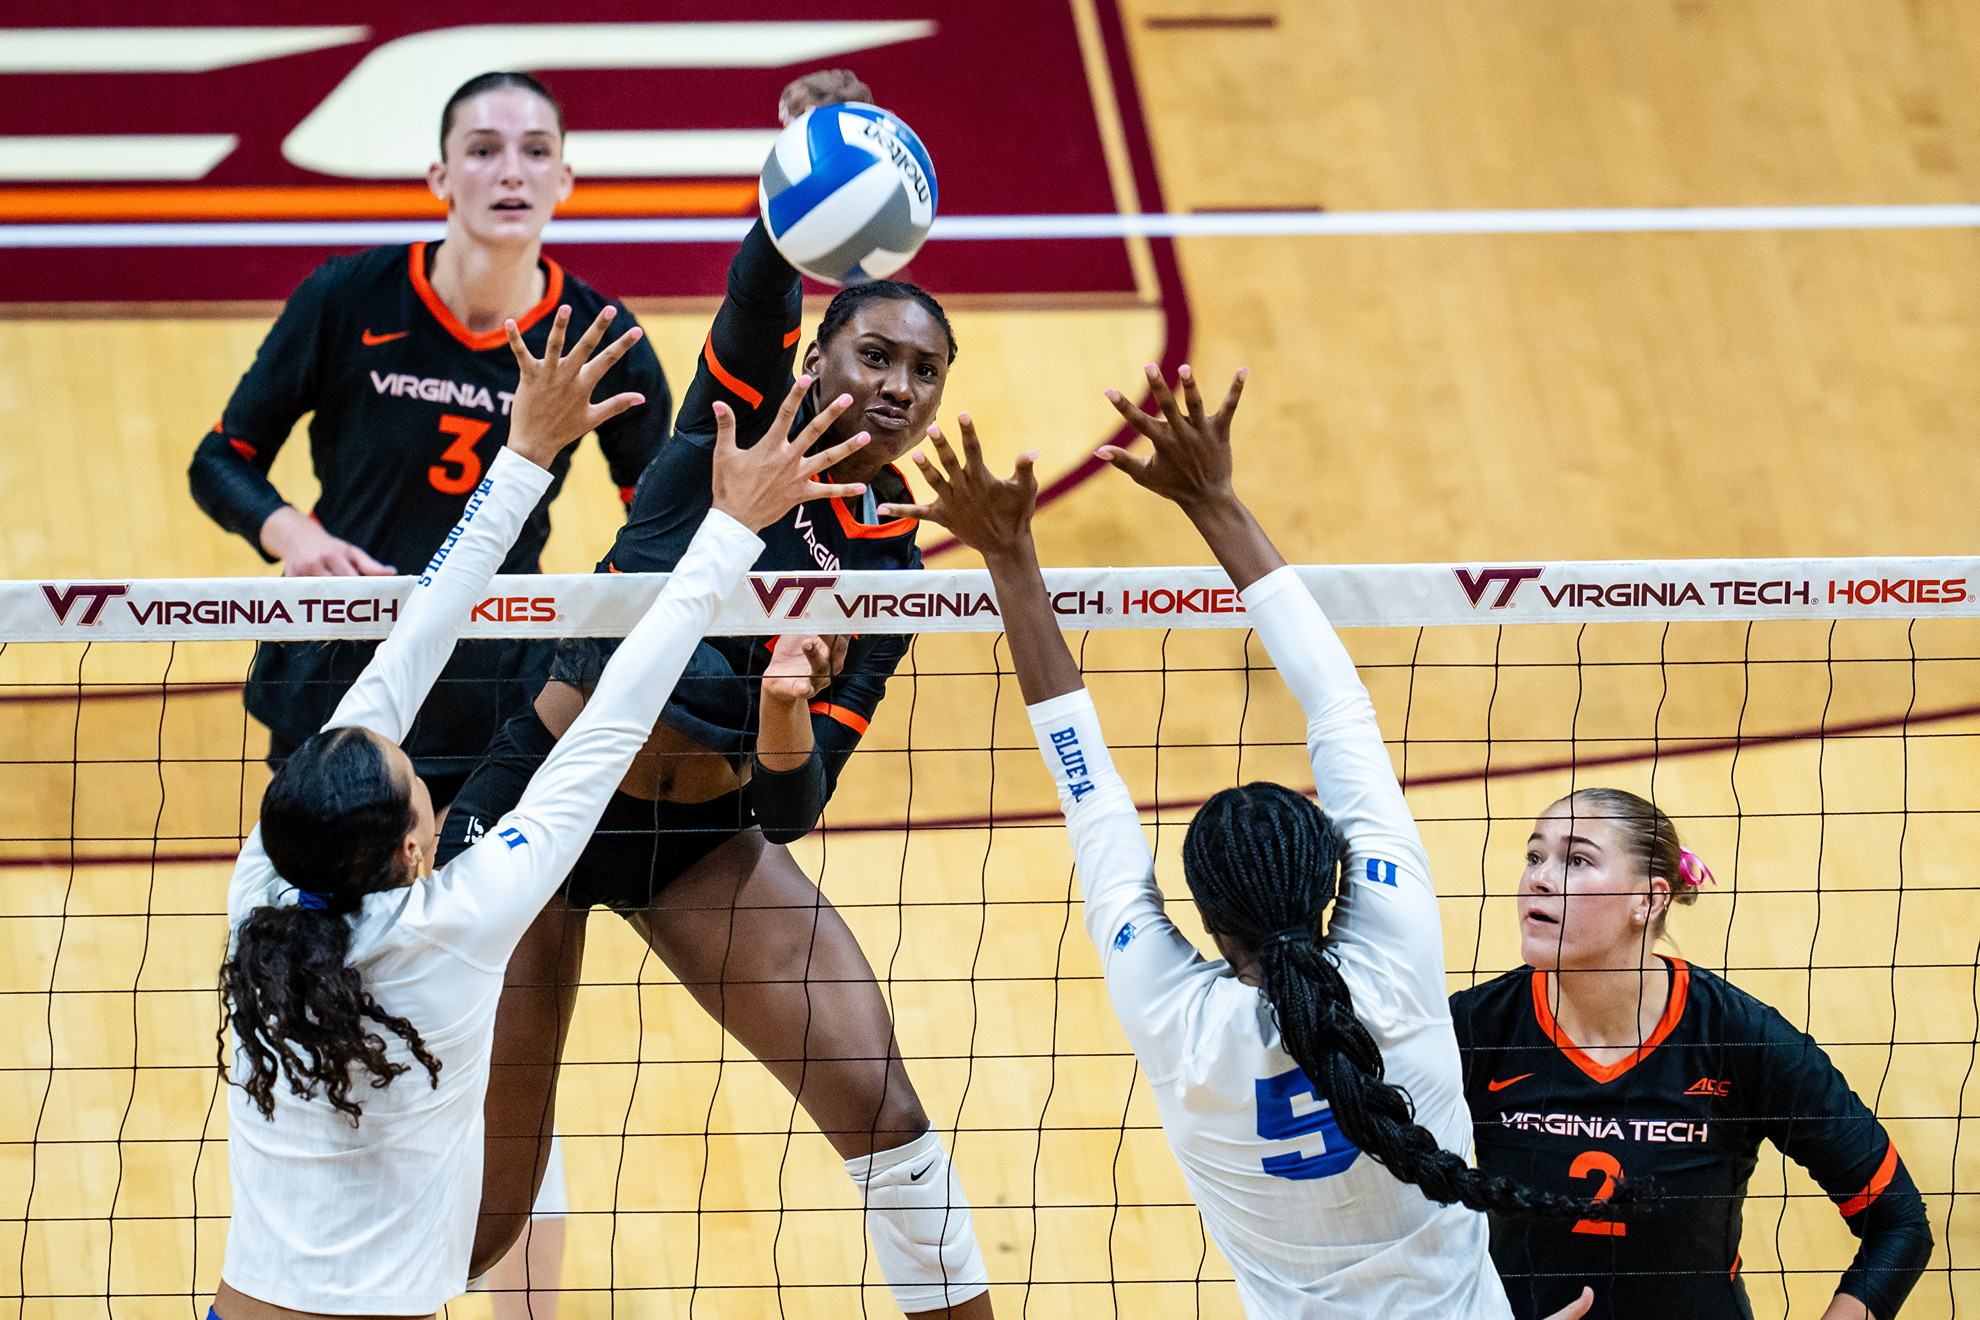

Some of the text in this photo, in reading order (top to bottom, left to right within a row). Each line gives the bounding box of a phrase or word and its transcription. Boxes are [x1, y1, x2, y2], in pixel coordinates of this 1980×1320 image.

[863, 124, 930, 203] molten
[370, 370, 495, 413] VIRGINIA
[428, 414, 492, 495] 3
[38, 582, 556, 626] VT VIRGINIA TECH KIES
[746, 574, 841, 619] VT
[833, 592, 1000, 619] VIRGINIA
[1451, 566, 1967, 610] VT VIRGINIA TECH HOKIES
[1050, 726, 1088, 779] BLUE
[1686, 1077, 1733, 1096] ACC
[1255, 1066, 1364, 1181] 5
[1500, 1111, 1709, 1143] VIRGINIA TECH
[1568, 1150, 1627, 1237] 2
